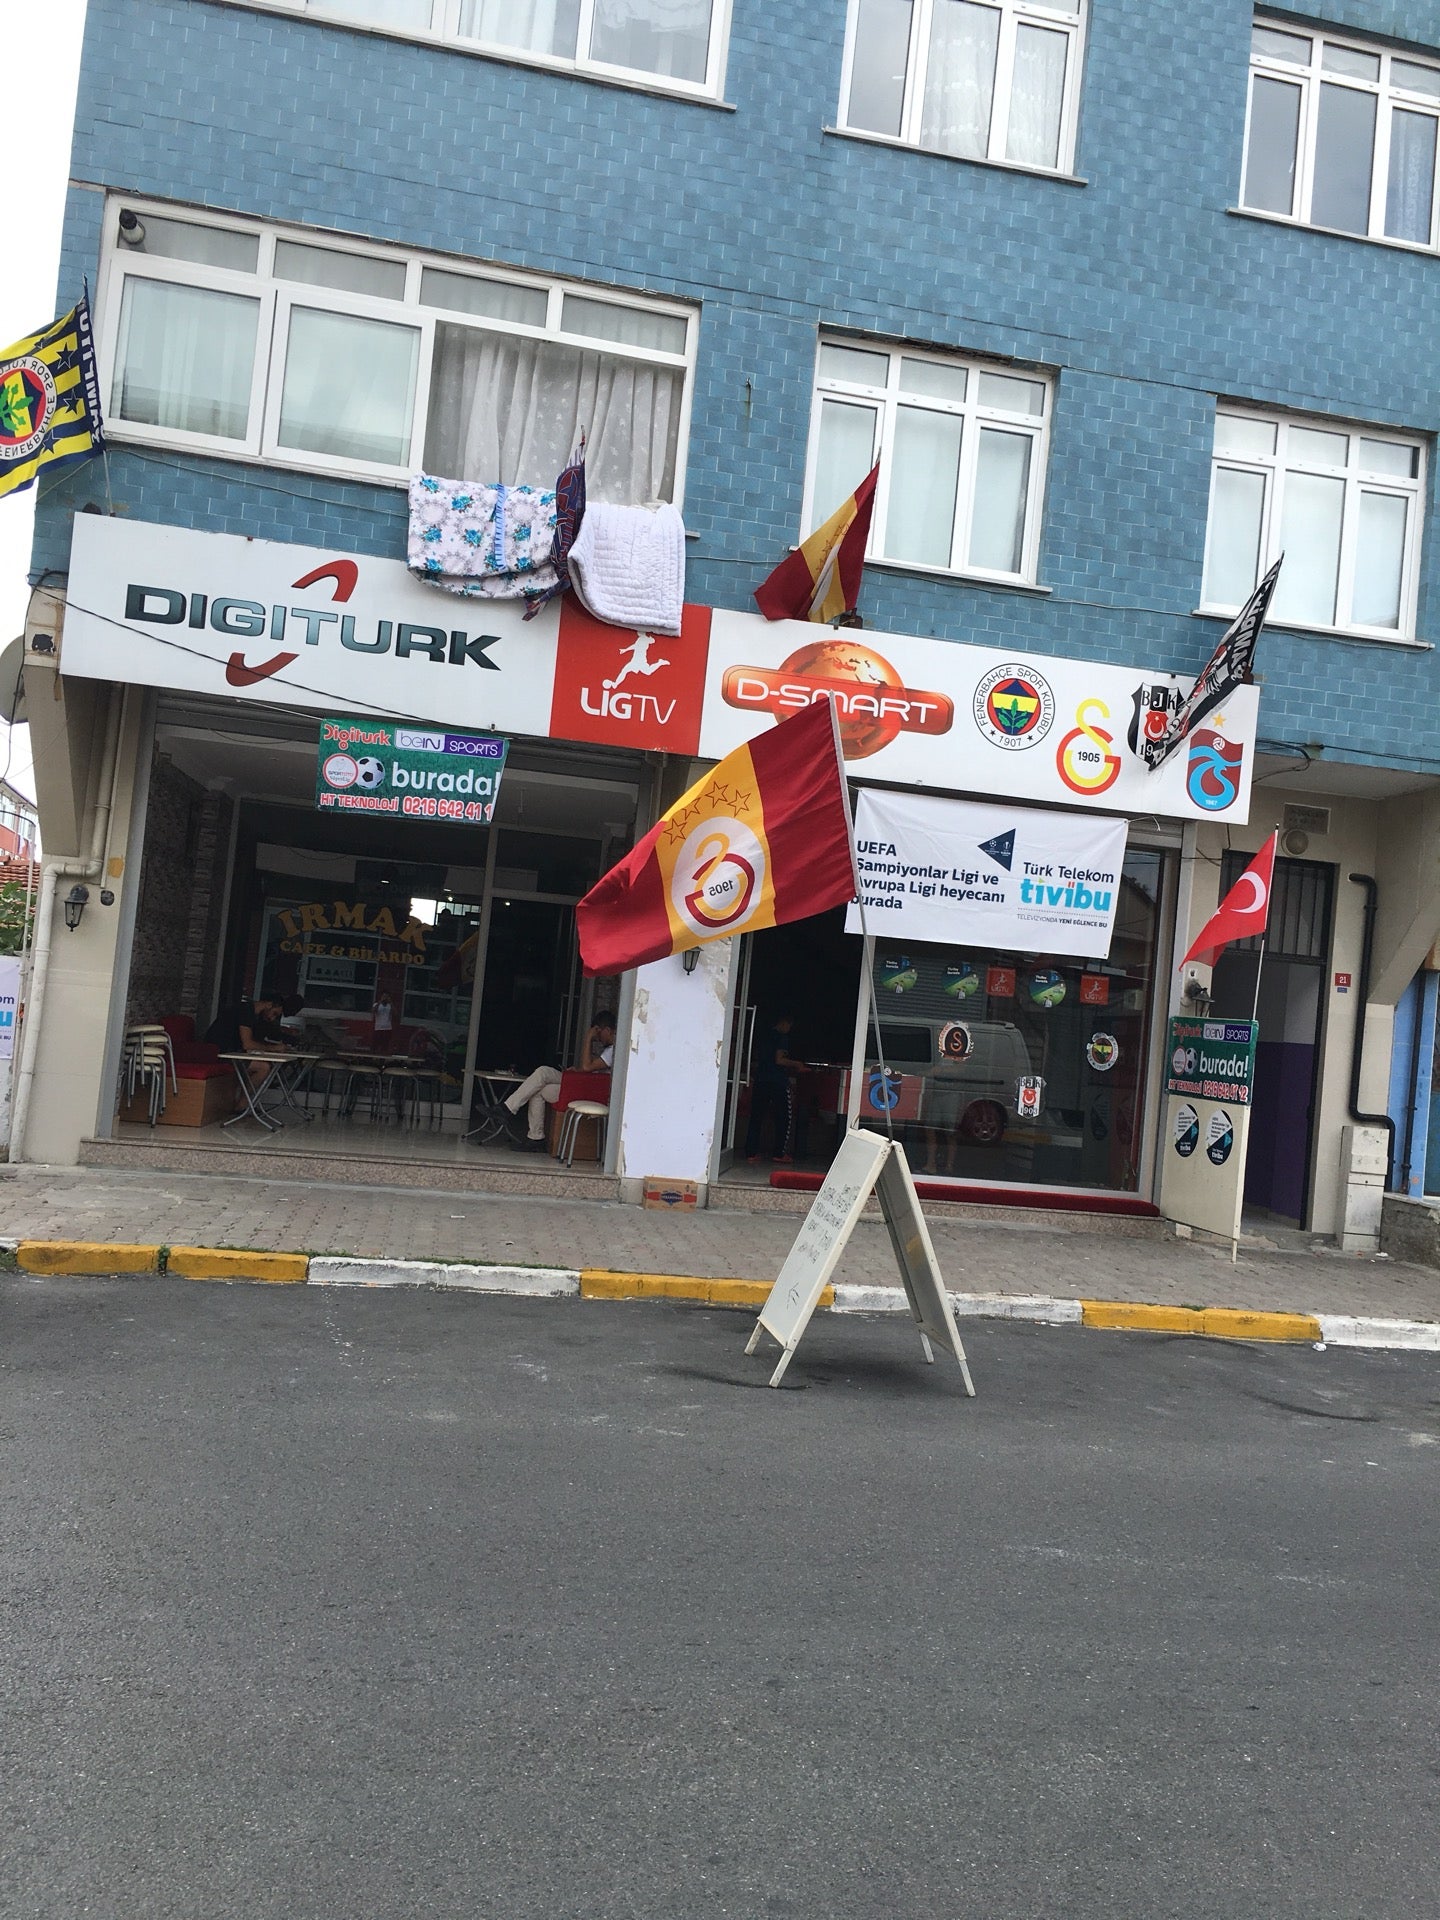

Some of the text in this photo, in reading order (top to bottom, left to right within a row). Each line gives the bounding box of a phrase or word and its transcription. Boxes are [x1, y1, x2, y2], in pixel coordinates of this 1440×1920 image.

[125, 584, 502, 671] DIGITURK
[737, 678, 937, 724] D-SMART
[976, 667, 1013, 727] FENERBAHÇE
[1017, 668, 1044, 690] SPOR
[1142, 690, 1177, 711] BJK
[450, 740, 498, 756] SPORTS
[1000, 735, 1022, 748] 1907
[1078, 751, 1101, 763] 1905
[321, 793, 335, 806] HT
[339, 795, 399, 811] TEKNOLOJİ
[403, 797, 435, 815] 0216
[438, 799, 463, 818] 642
[465, 801, 482, 821] 41
[857, 840, 897, 857] UEFA
[857, 858, 999, 885] Şampiyonlar Ligi ve
[1023, 862, 1114, 883] Türk Telekom
[909, 881, 936, 898] Ligi
[939, 886, 1005, 904] heyecanı
[1020, 878, 1112, 912] tivibu
[278, 900, 434, 951] IRMAK
[280, 940, 425, 966] CAFE & BİLARDO
[1340, 976, 1347, 984] 21
[1226, 1029, 1249, 1041] SPORTS
[1200, 1050, 1249, 1079] burada!
